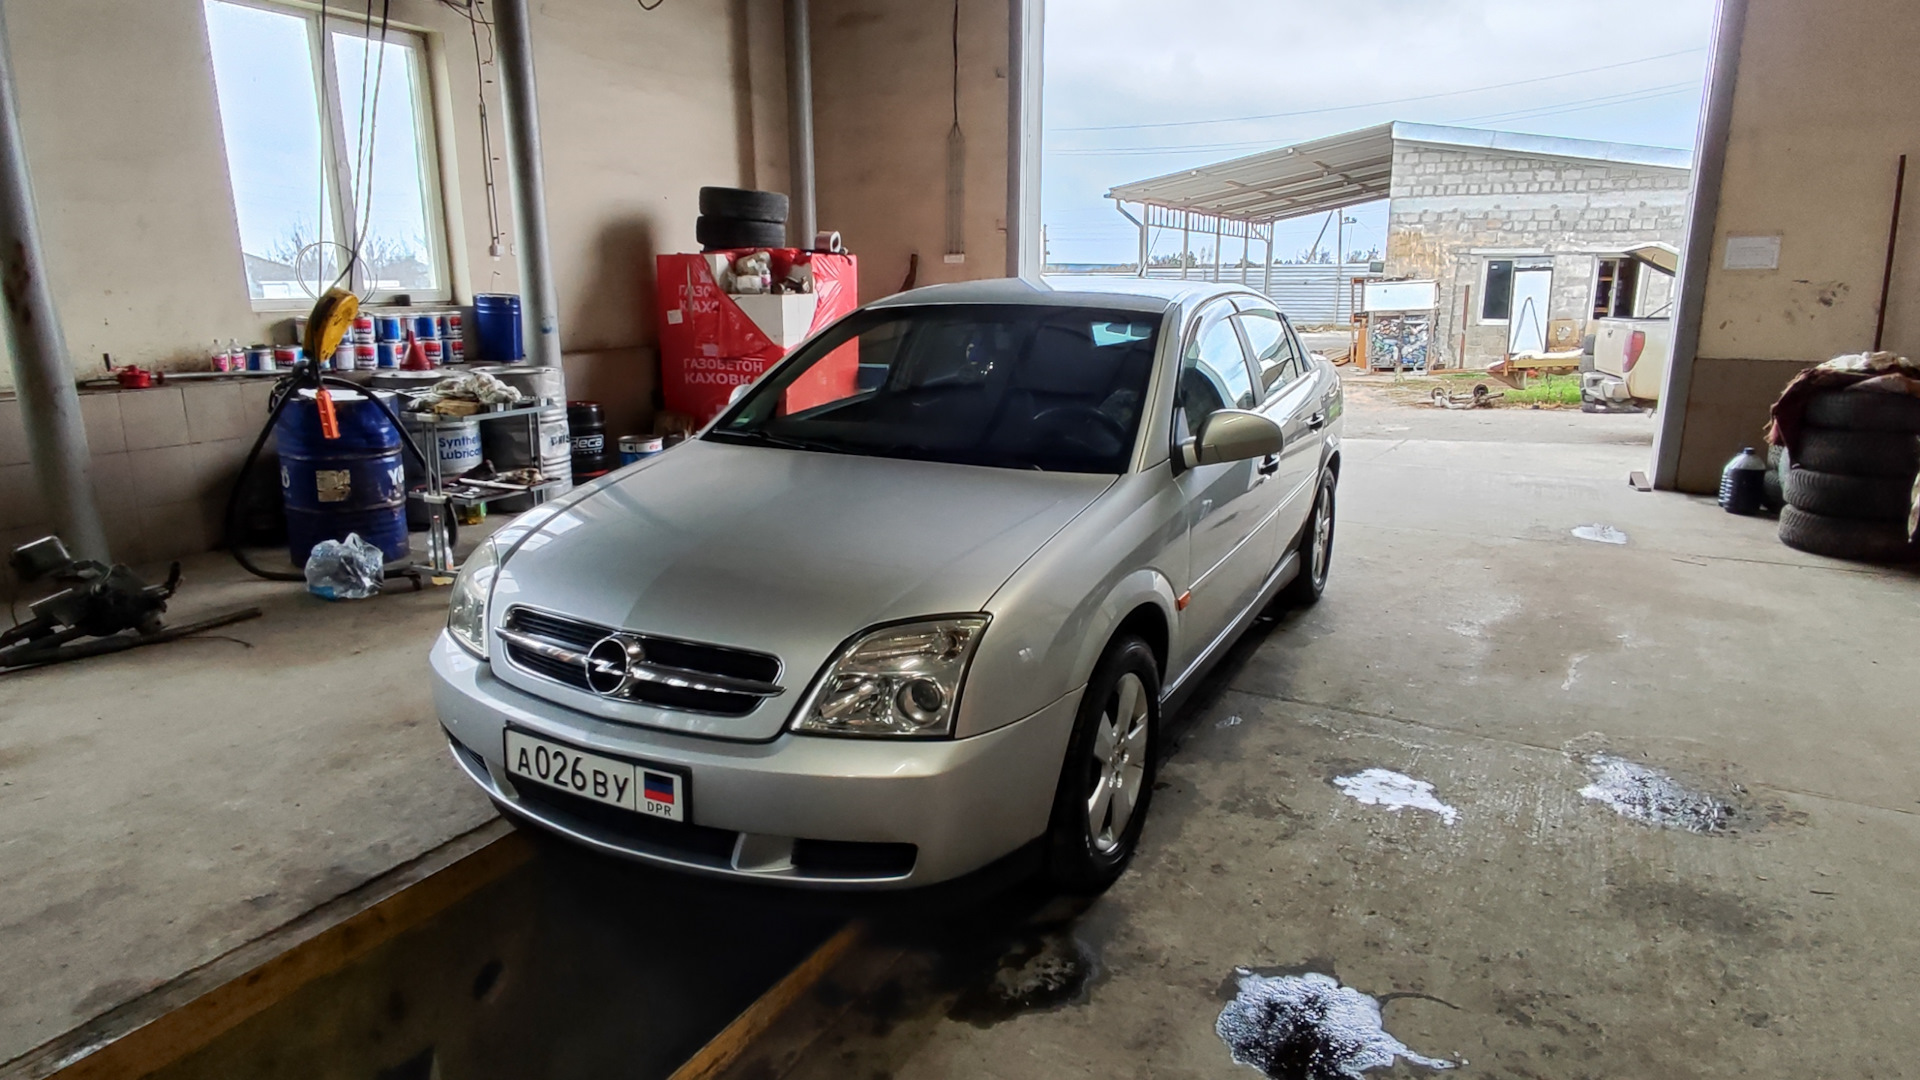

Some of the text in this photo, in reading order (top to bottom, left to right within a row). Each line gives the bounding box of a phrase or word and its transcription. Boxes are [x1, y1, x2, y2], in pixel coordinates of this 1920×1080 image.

[683, 358, 764, 373] ГАЗОБЕТОН
[517, 745, 630, 803] А026ВУ
[646, 800, 672, 817] DPR
